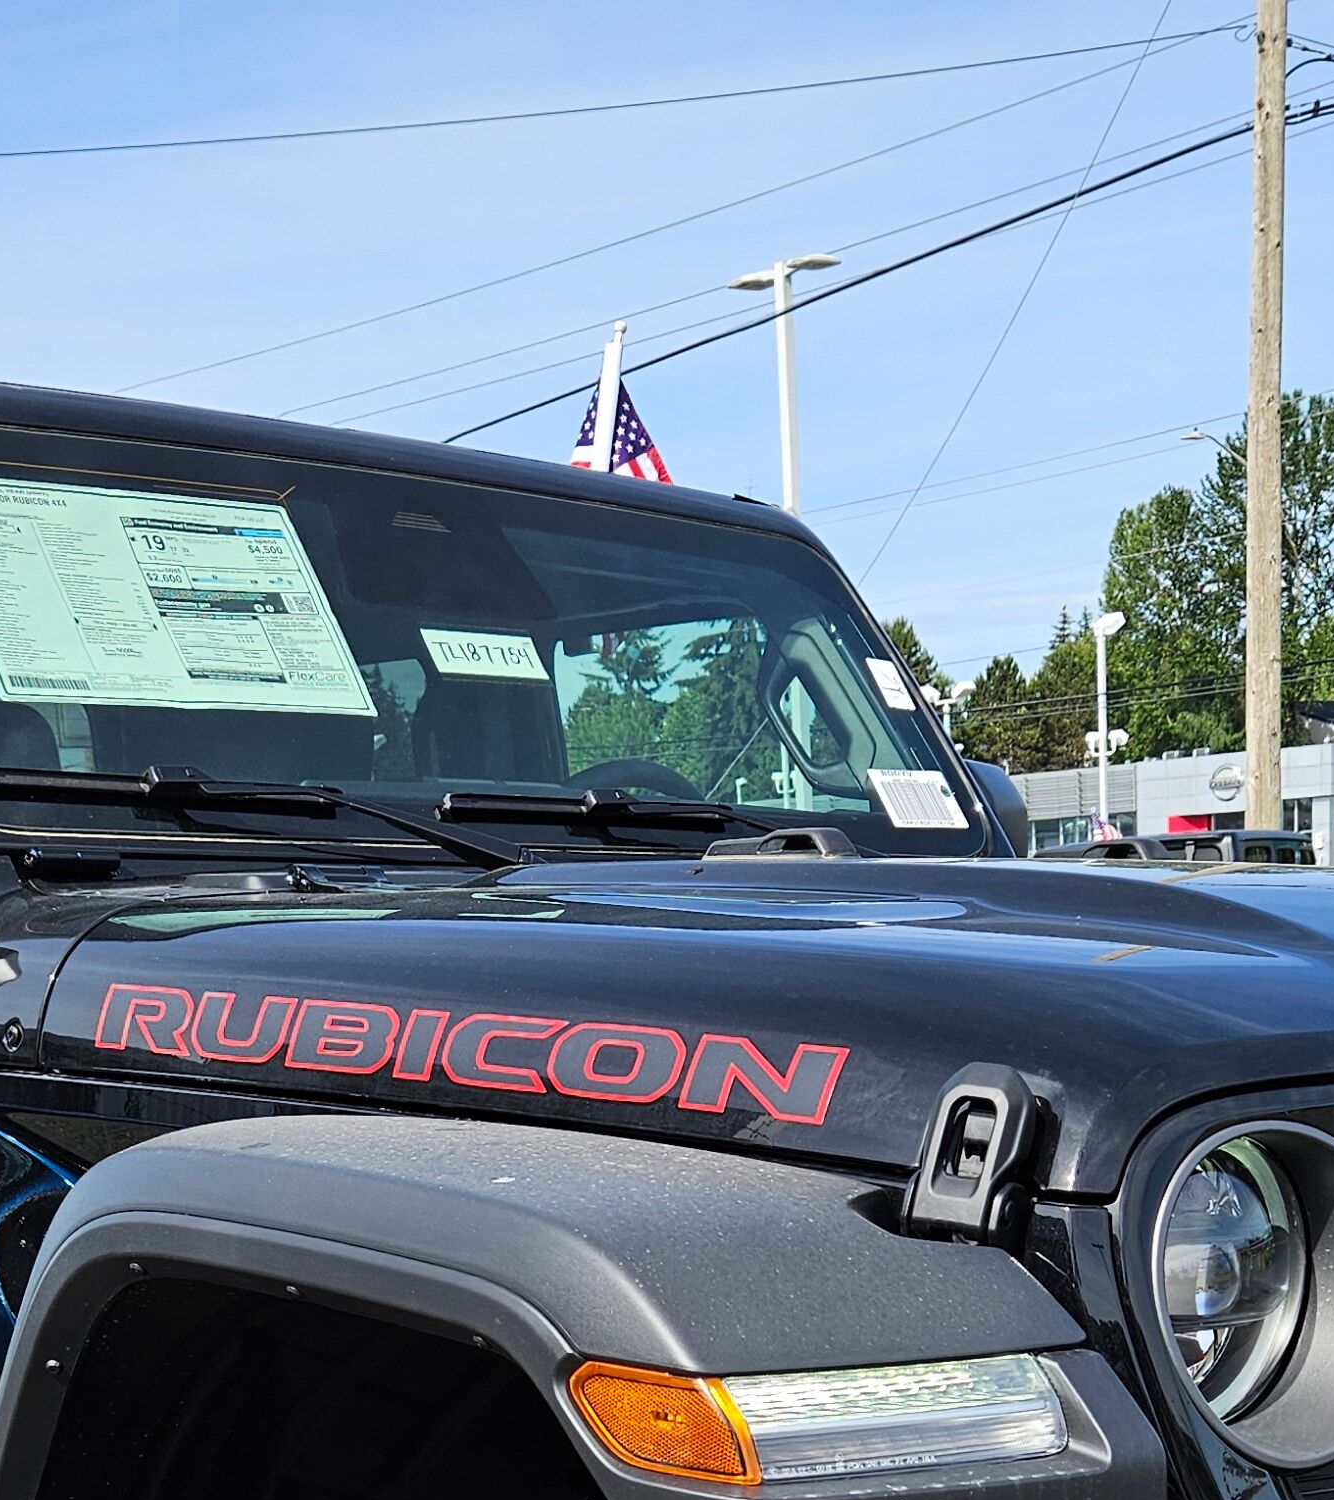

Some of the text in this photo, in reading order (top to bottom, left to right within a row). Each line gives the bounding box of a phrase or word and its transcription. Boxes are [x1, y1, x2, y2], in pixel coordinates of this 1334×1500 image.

[12, 495, 50, 506] RUBICON
[142, 534, 166, 551] 19
[248, 544, 283, 555] $4,500
[146, 572, 183, 584] $2,600
[288, 671, 346, 682] FlexCare
[95, 982, 851, 1126] RUBICON
